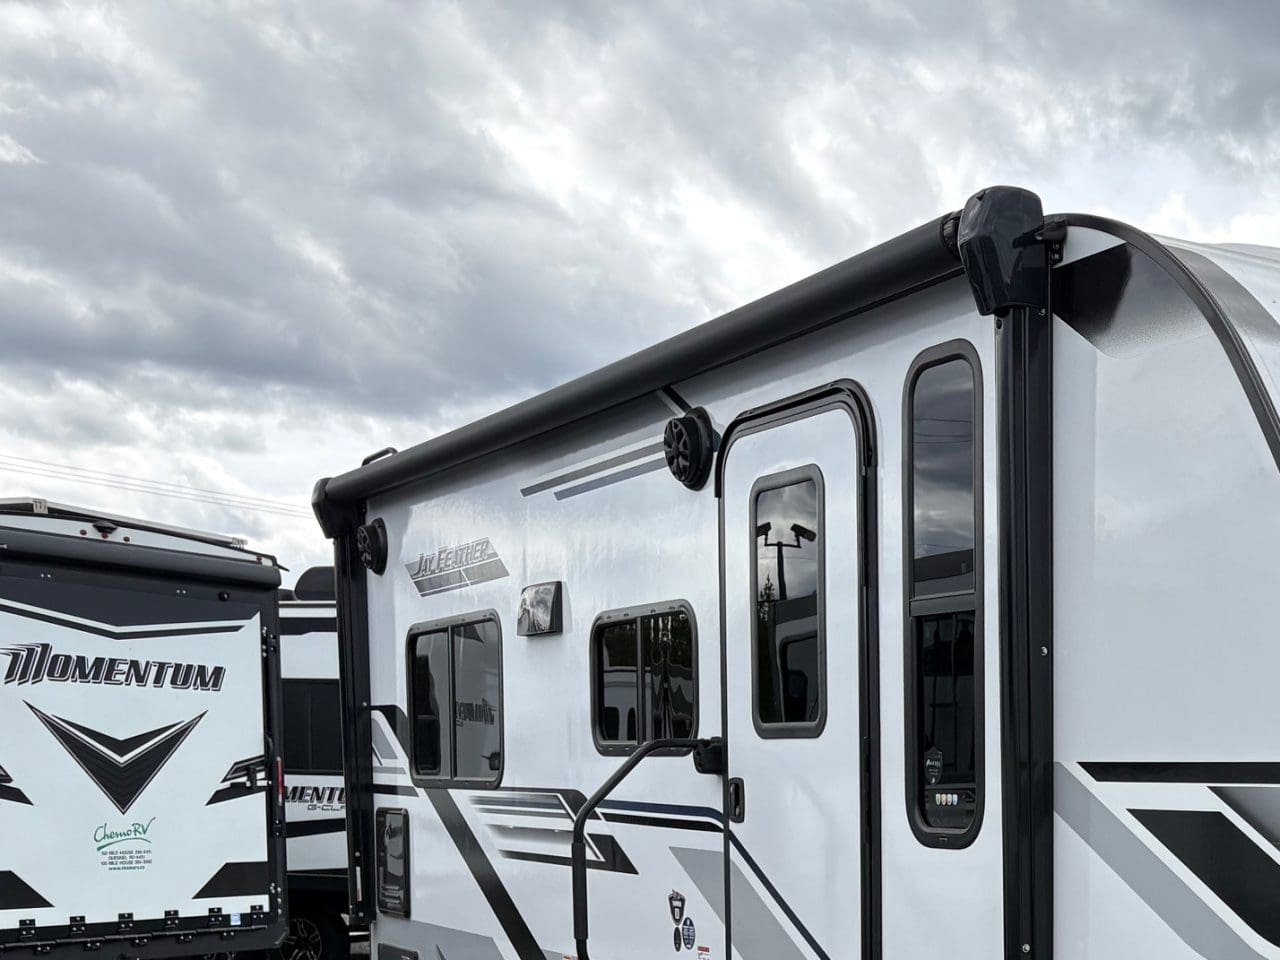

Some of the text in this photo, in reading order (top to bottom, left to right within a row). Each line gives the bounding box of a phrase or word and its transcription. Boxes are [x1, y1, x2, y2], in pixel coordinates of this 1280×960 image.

[411, 537, 489, 579] JAY FEATHER
[0, 643, 226, 692] MOMENTUM
